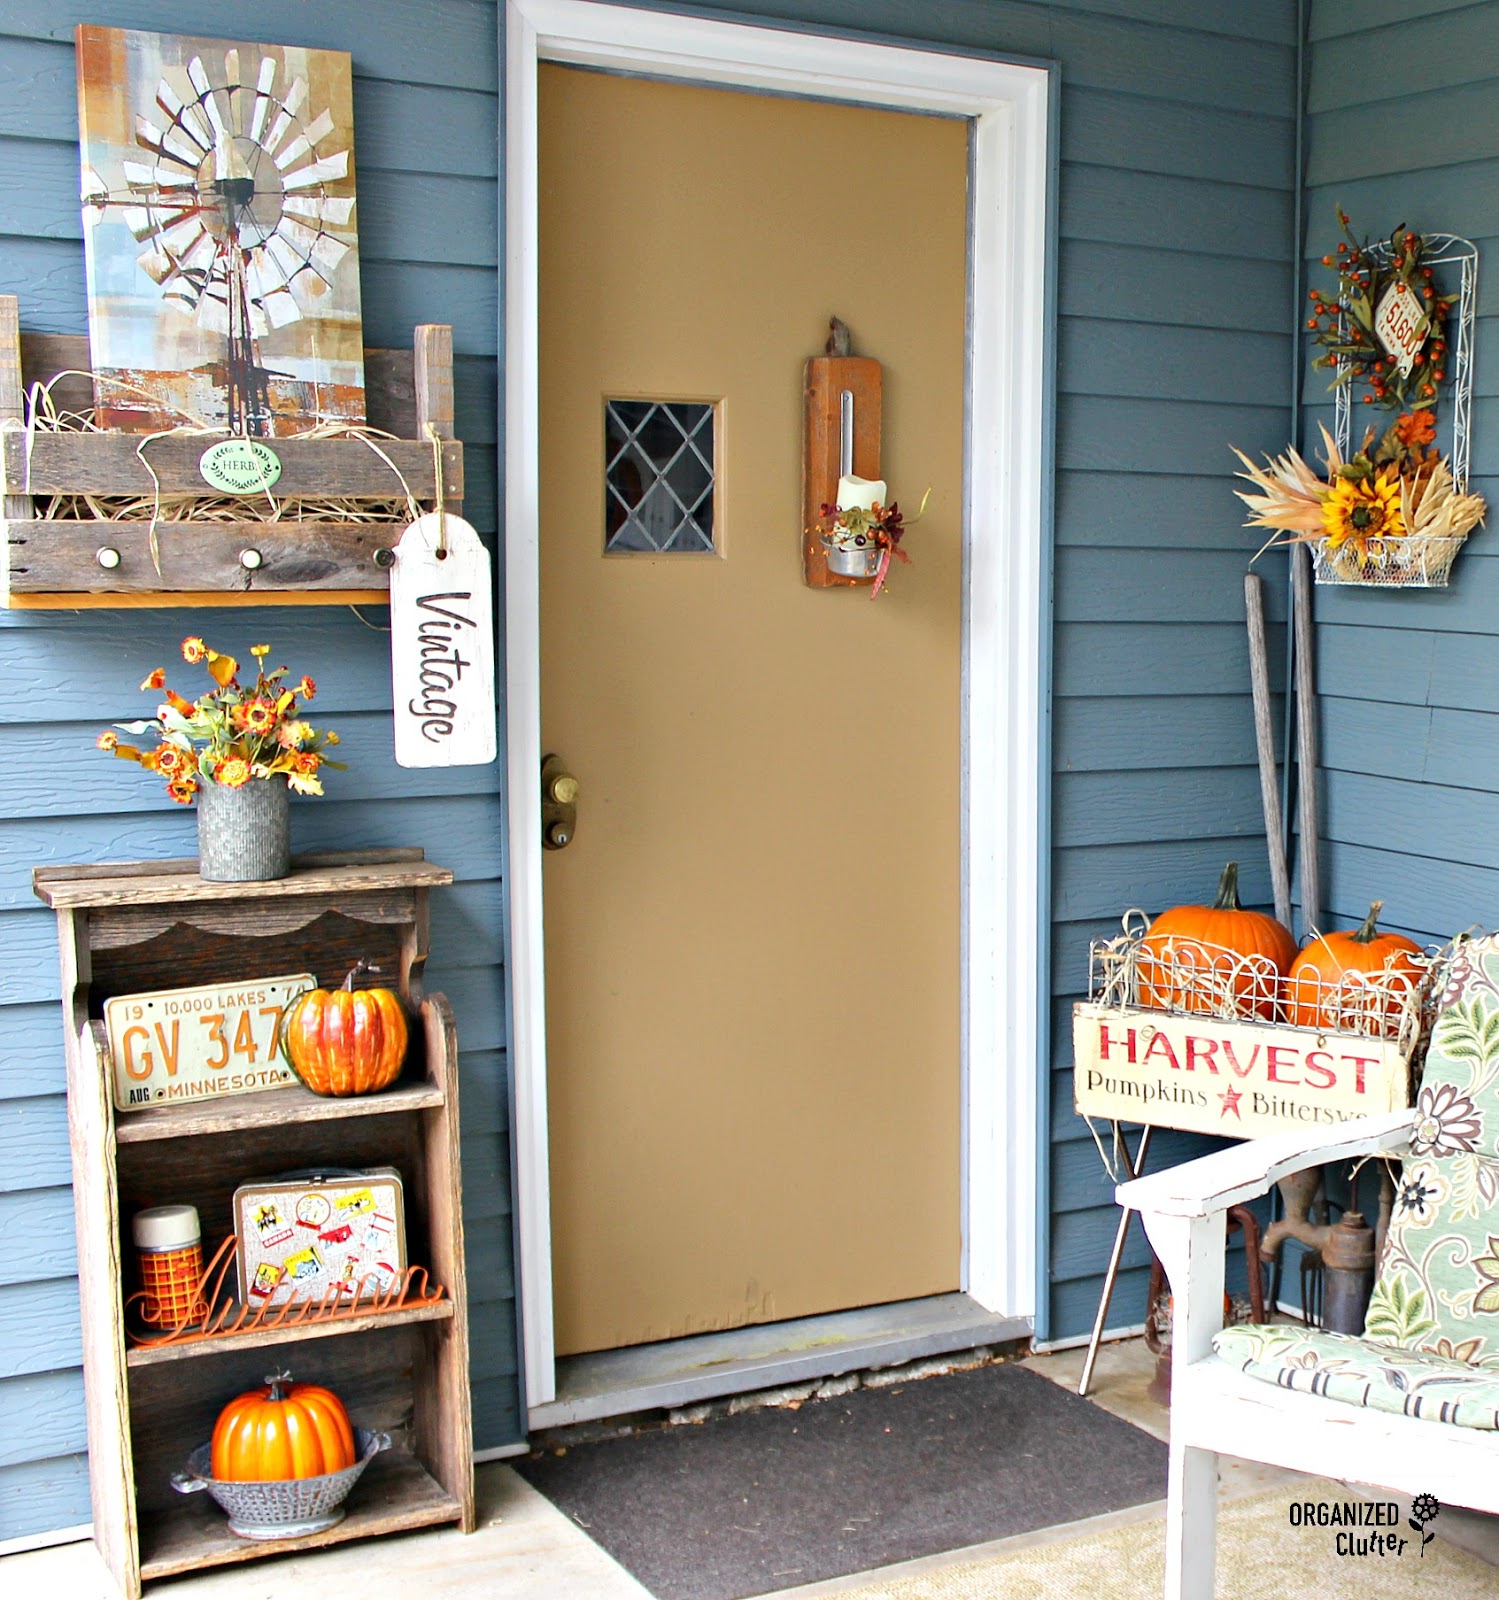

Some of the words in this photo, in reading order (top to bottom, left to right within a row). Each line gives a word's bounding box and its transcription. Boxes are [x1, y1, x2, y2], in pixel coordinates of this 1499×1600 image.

[409, 592, 477, 743] Vintage
[125, 1004, 144, 1021] 19
[218, 990, 266, 1009] LAKES
[122, 1019, 180, 1081] GV
[200, 1005, 284, 1070] 347
[1100, 1025, 1380, 1094] HARVEST
[129, 1086, 150, 1104] AUG
[168, 1070, 282, 1097] MINNESOTA
[1087, 1069, 1208, 1107] Pumpkins
[124, 1235, 443, 1344] Autumn
